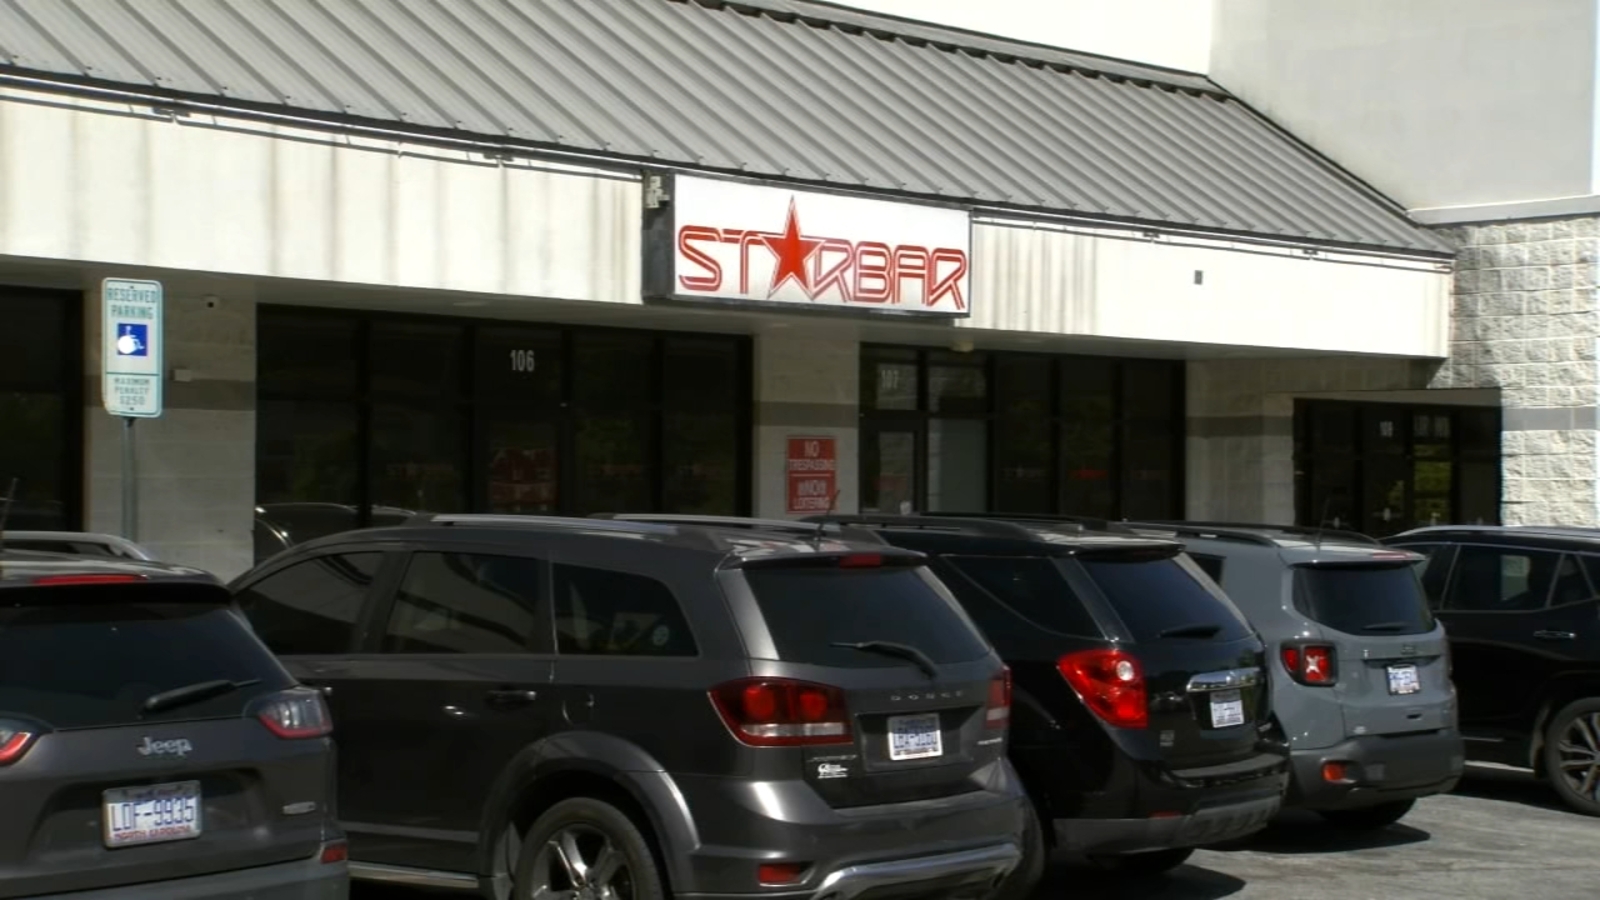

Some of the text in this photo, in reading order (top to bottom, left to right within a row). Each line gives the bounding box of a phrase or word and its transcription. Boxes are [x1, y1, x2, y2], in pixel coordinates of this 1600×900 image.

[107, 287, 156, 303] RESERVED
[111, 304, 153, 320] PARKING
[510, 349, 535, 372] 106
[114, 377, 150, 386] MAXIMUM
[114, 386, 150, 395] PENALTY
[804, 440, 820, 457] NO
[138, 737, 192, 756] Jeep
